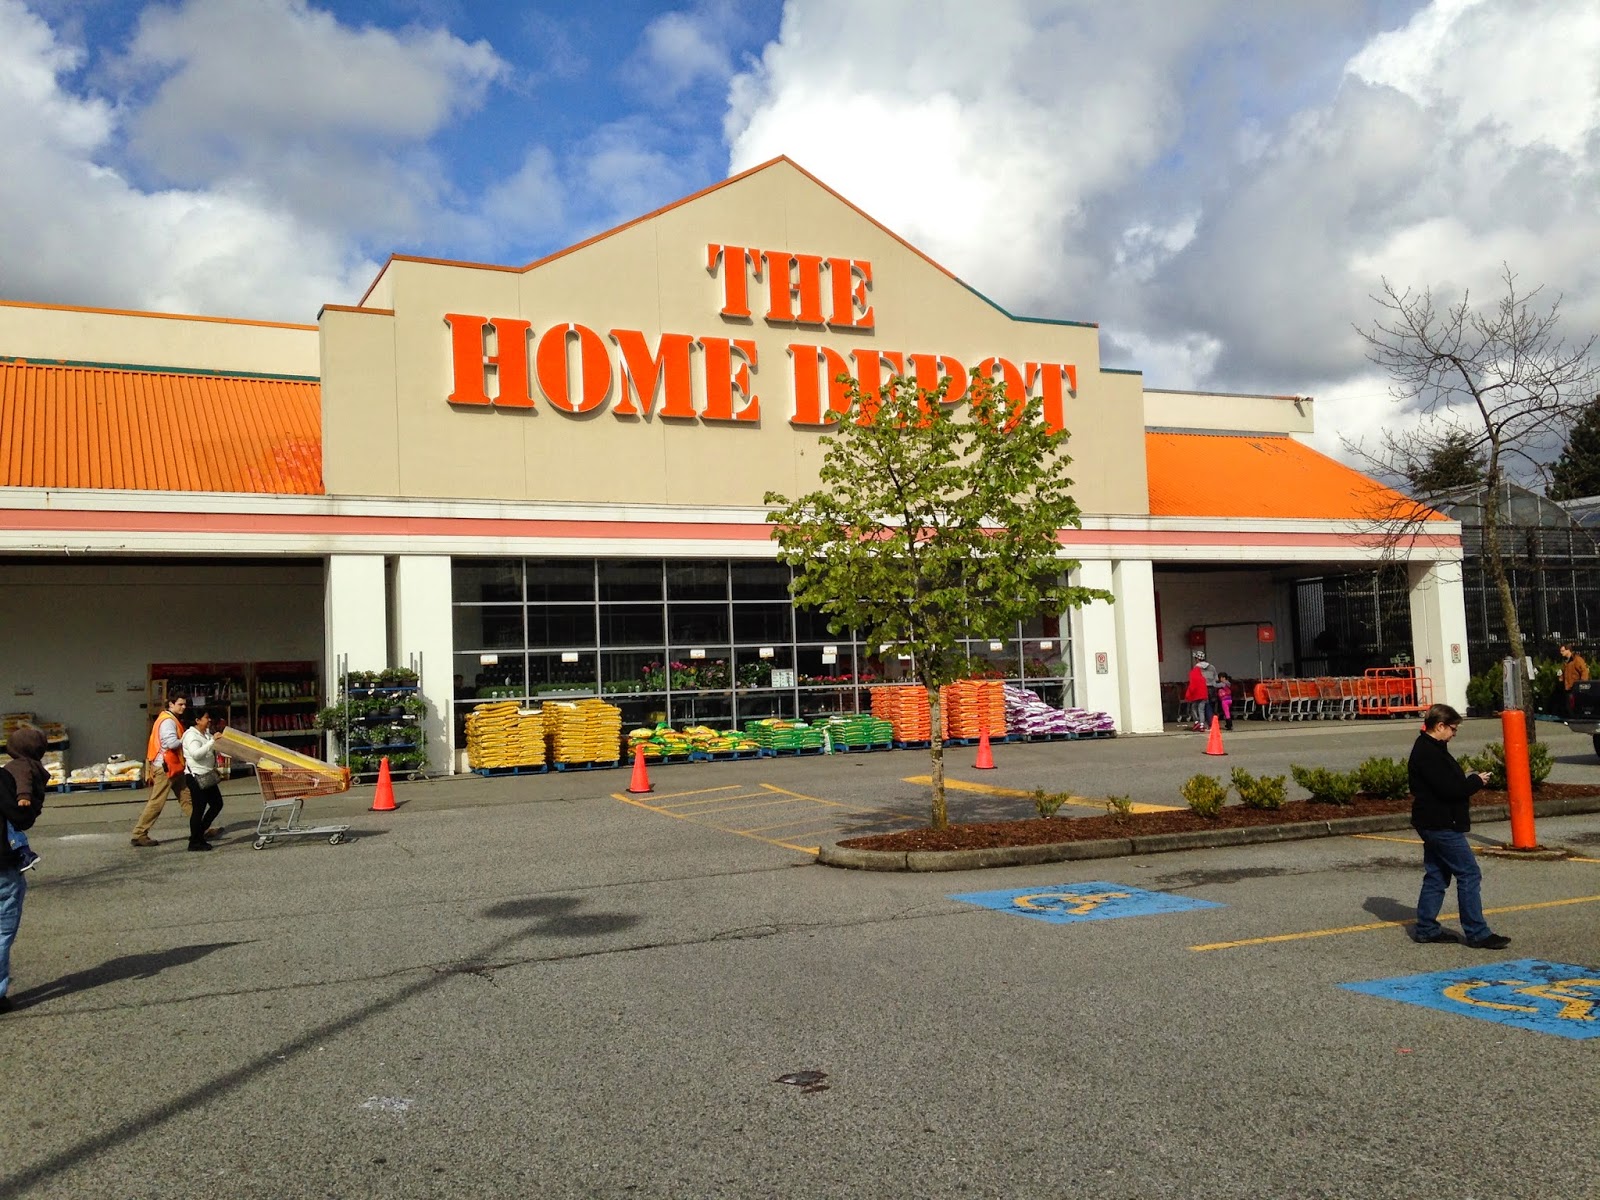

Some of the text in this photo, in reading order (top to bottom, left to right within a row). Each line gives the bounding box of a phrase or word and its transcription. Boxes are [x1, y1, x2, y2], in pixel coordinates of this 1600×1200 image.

[706, 243, 875, 328] THE
[444, 312, 1077, 437] HOME DEPOT
